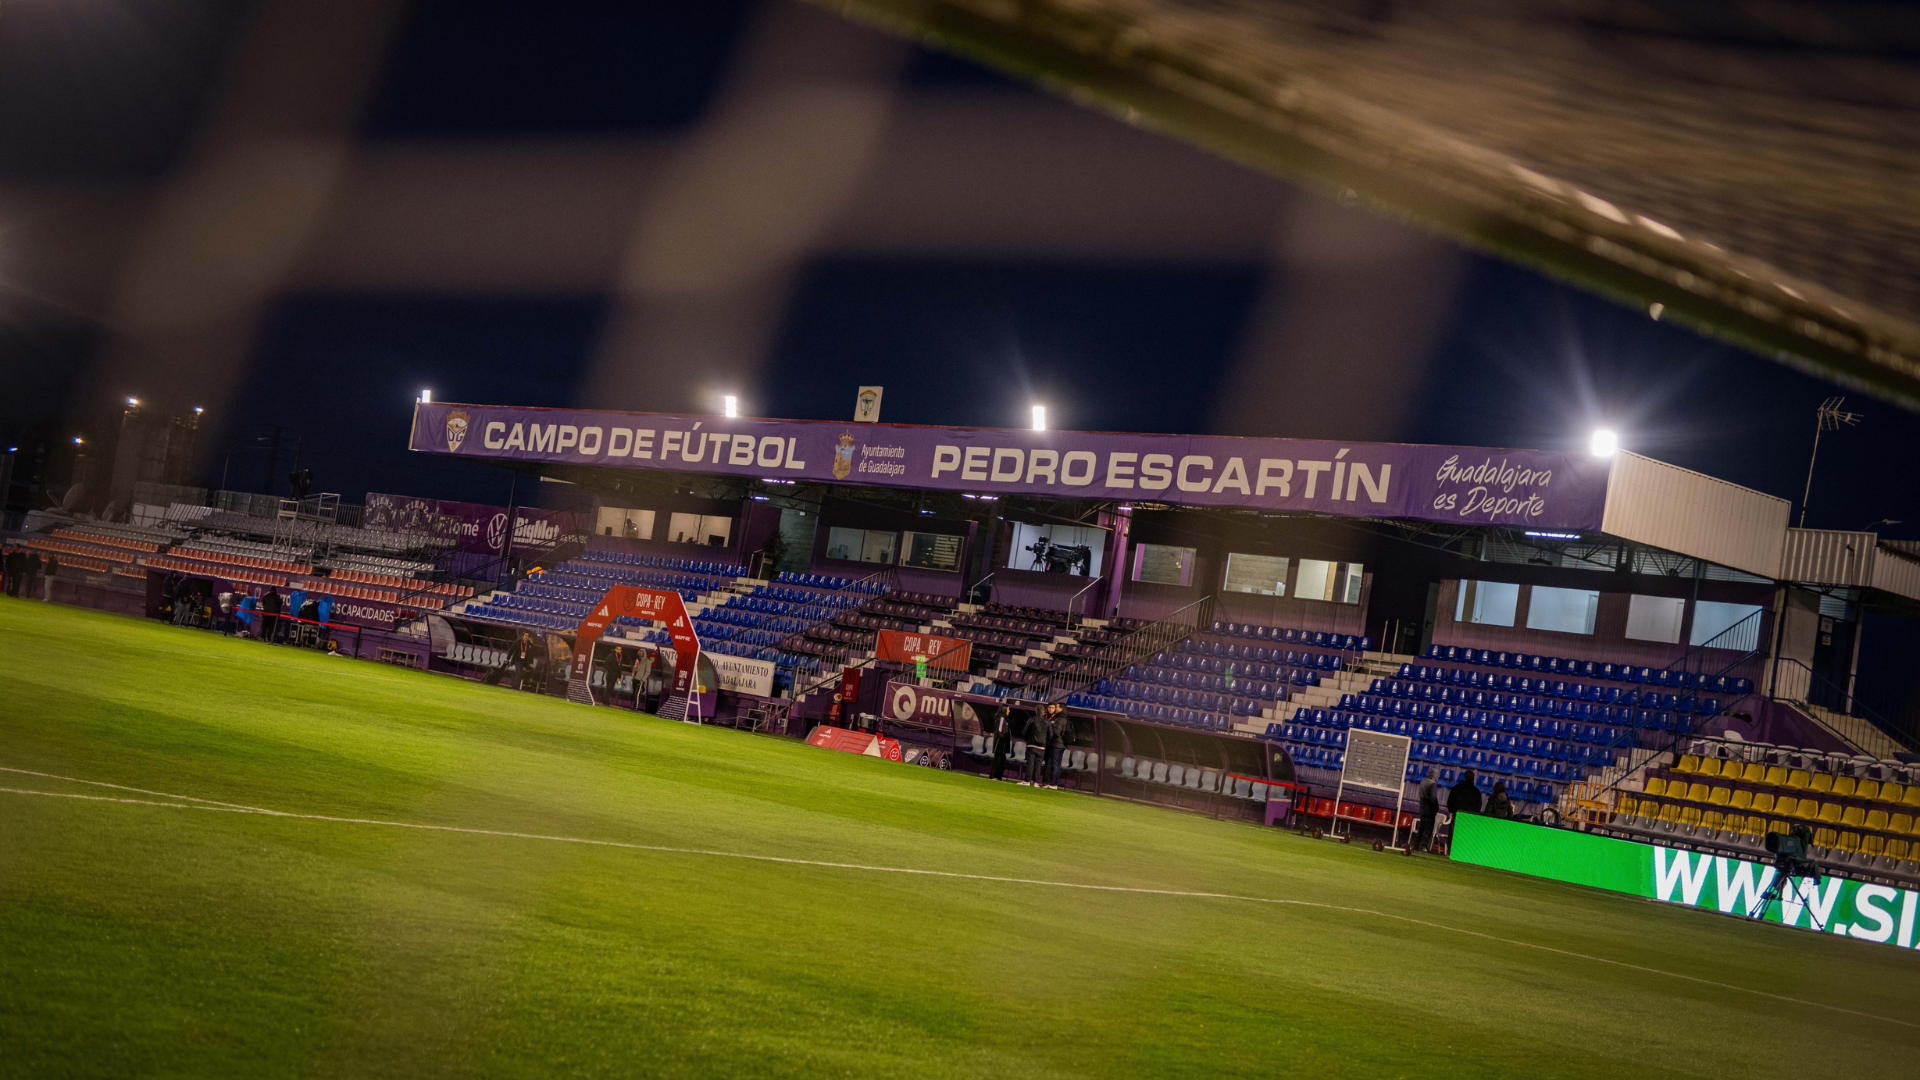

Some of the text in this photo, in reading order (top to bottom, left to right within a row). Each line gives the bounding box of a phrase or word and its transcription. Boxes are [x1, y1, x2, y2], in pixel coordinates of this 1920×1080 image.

[484, 421, 806, 470] CAMPO DE FÚTBOL
[861, 443, 905, 459] Ayuntamiento
[858, 459, 905, 477] de Guadalajara
[931, 444, 1392, 503] PEDRO ESCARTÍN
[1435, 454, 1552, 493] Guadalajara
[1433, 486, 1545, 521] es Deporte
[514, 517, 560, 541] BigMat
[341, 604, 395, 623] CAPACIDADES
[903, 635, 942, 655] COPA REY
[722, 661, 769, 677] AYUNTAMIENTO
[717, 673, 757, 689] UADALAJARA
[920, 695, 952, 717] mu
[1653, 845, 1920, 949] WWW.SI
